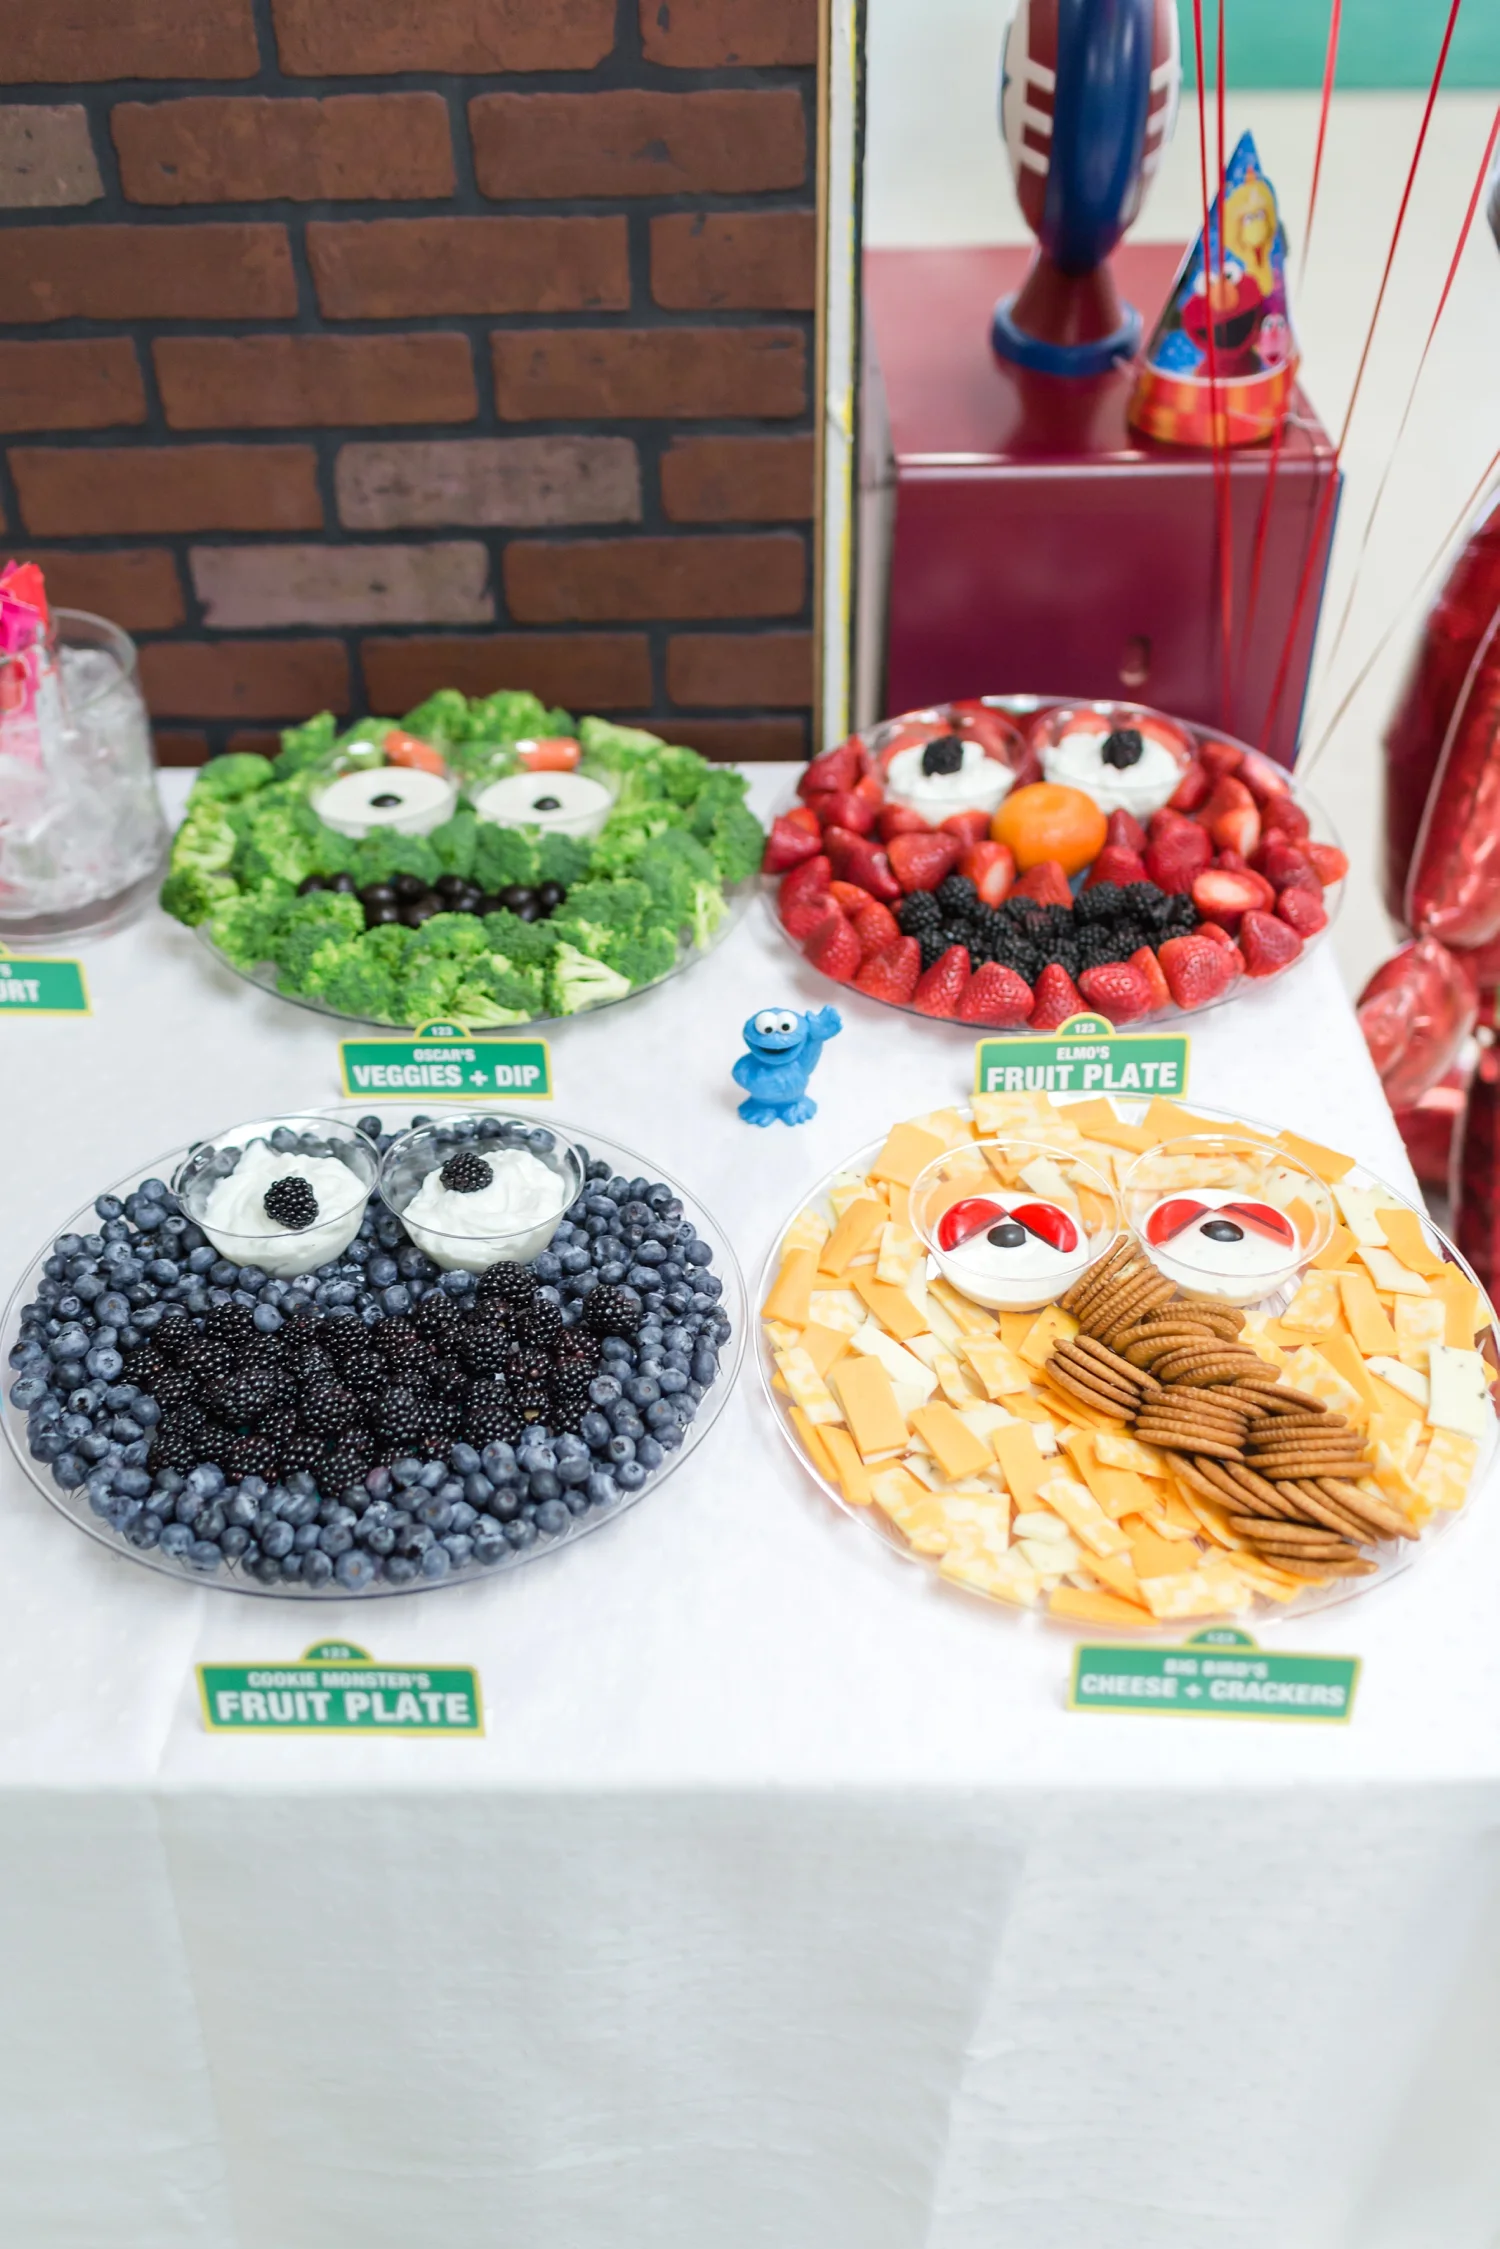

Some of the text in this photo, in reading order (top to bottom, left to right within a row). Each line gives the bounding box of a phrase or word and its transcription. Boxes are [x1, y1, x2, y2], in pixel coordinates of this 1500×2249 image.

[431, 1026, 454, 1037] 123
[1074, 1022, 1096, 1034] 123
[413, 1048, 476, 1063] OSCAR'S
[1056, 1045, 1110, 1061] ELMO'S
[352, 1065, 541, 1088] VEGGIES + DIP
[987, 1062, 1178, 1092] FRUIT PLATE
[247, 1671, 431, 1690] COOKIE MONSTER'S
[1080, 1673, 1178, 1698] CHEESE
[1209, 1679, 1346, 1707] CRACKERS
[216, 1691, 471, 1723] FRUIT PLATE
